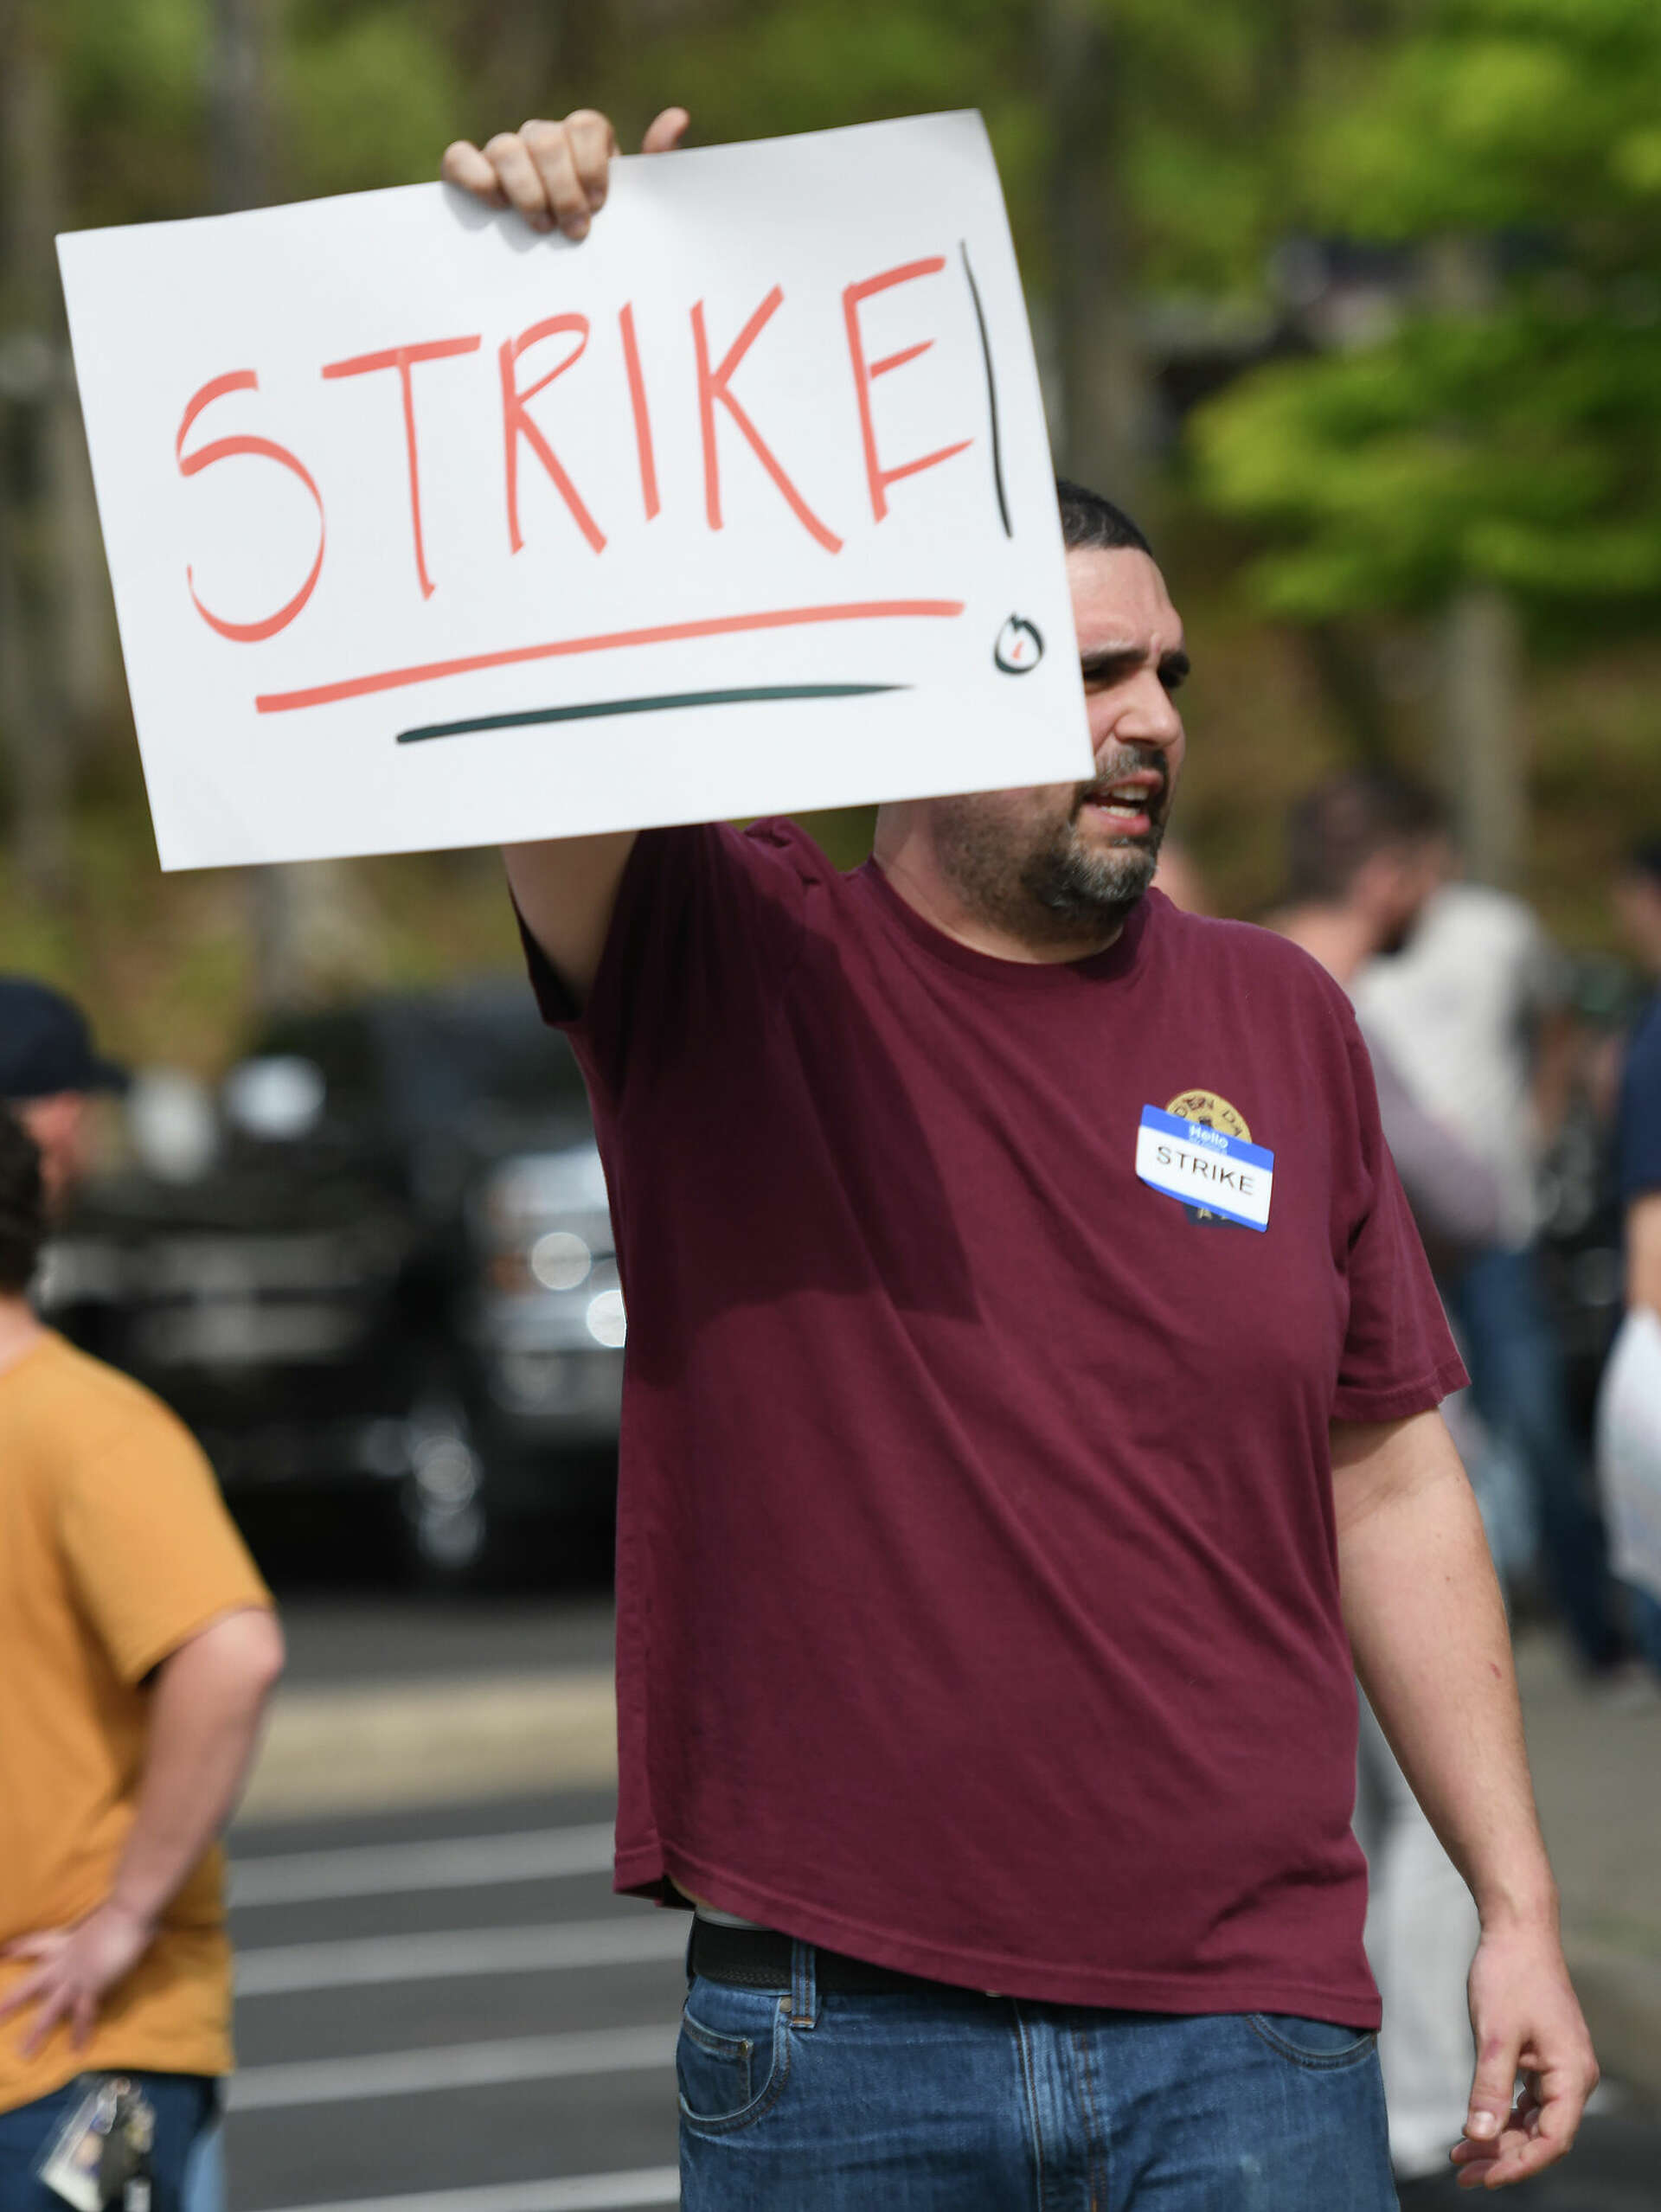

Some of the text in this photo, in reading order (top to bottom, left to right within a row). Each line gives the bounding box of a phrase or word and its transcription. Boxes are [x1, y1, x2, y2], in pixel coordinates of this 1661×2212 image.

[176, 240, 1045, 676] STRIKE!
[1189, 1125, 1228, 1149] Hello
[1157, 1145, 1254, 1196] STRIKE
